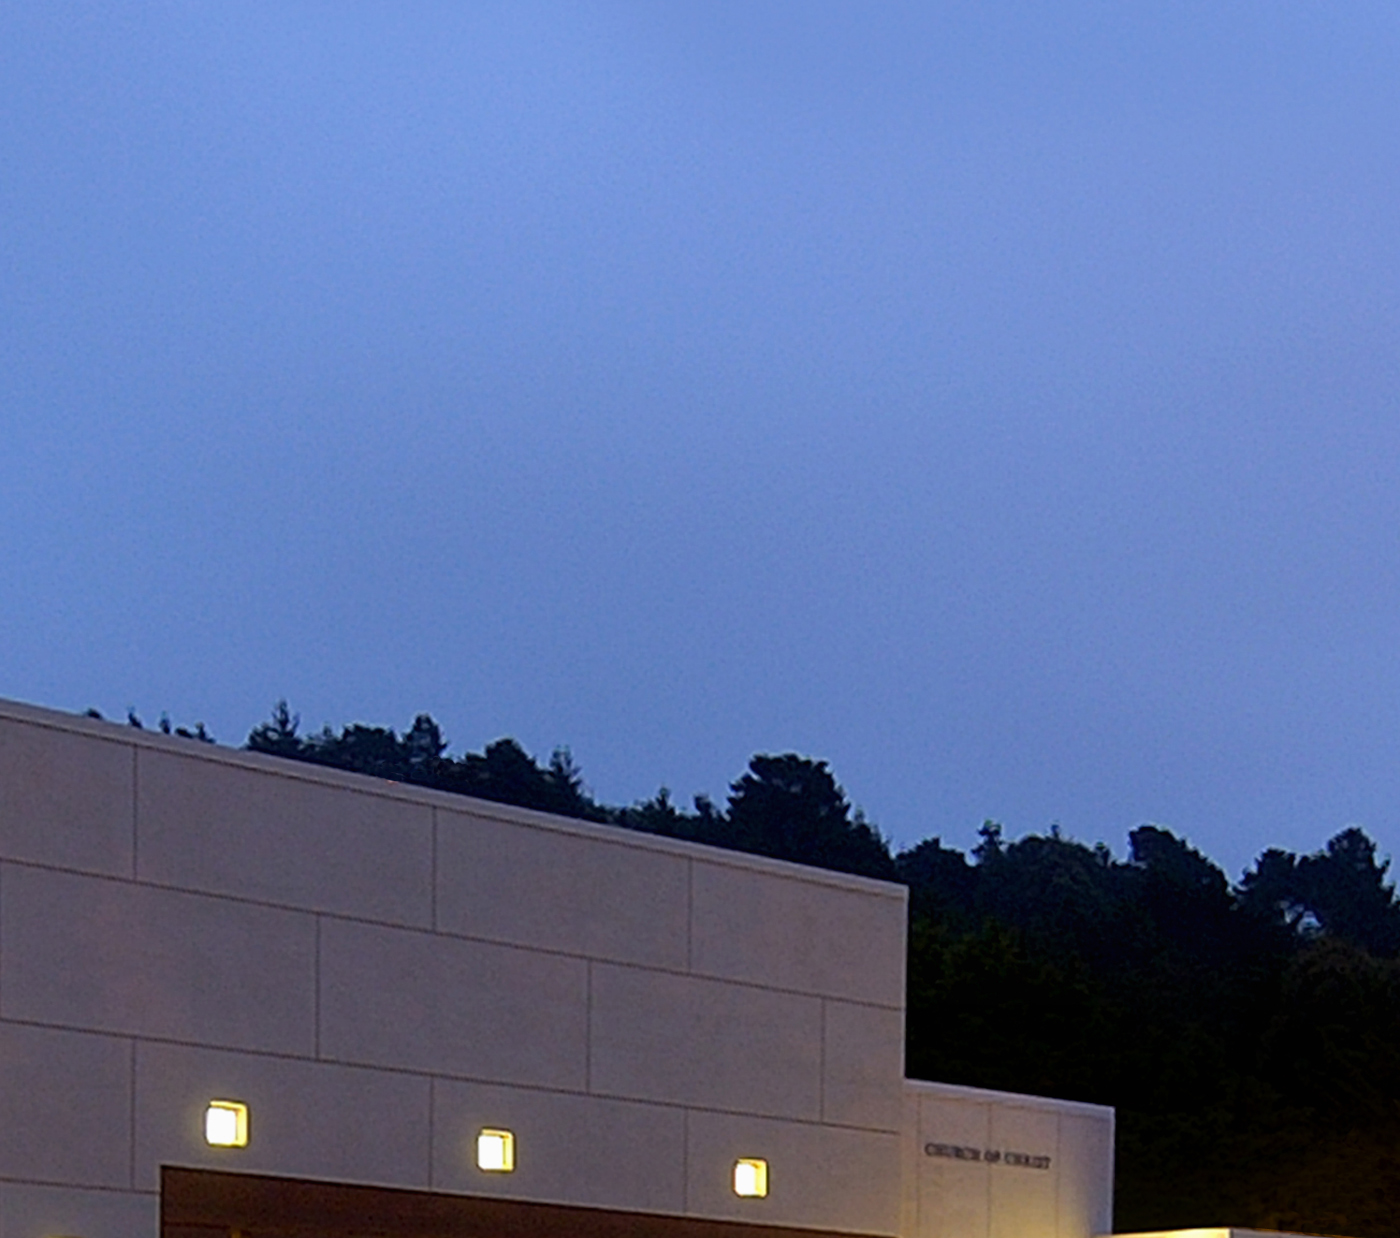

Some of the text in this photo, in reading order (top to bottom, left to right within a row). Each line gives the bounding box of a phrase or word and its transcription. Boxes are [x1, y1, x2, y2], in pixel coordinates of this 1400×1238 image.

[924, 1142, 1051, 1170] CHURCH OF CHRIST
